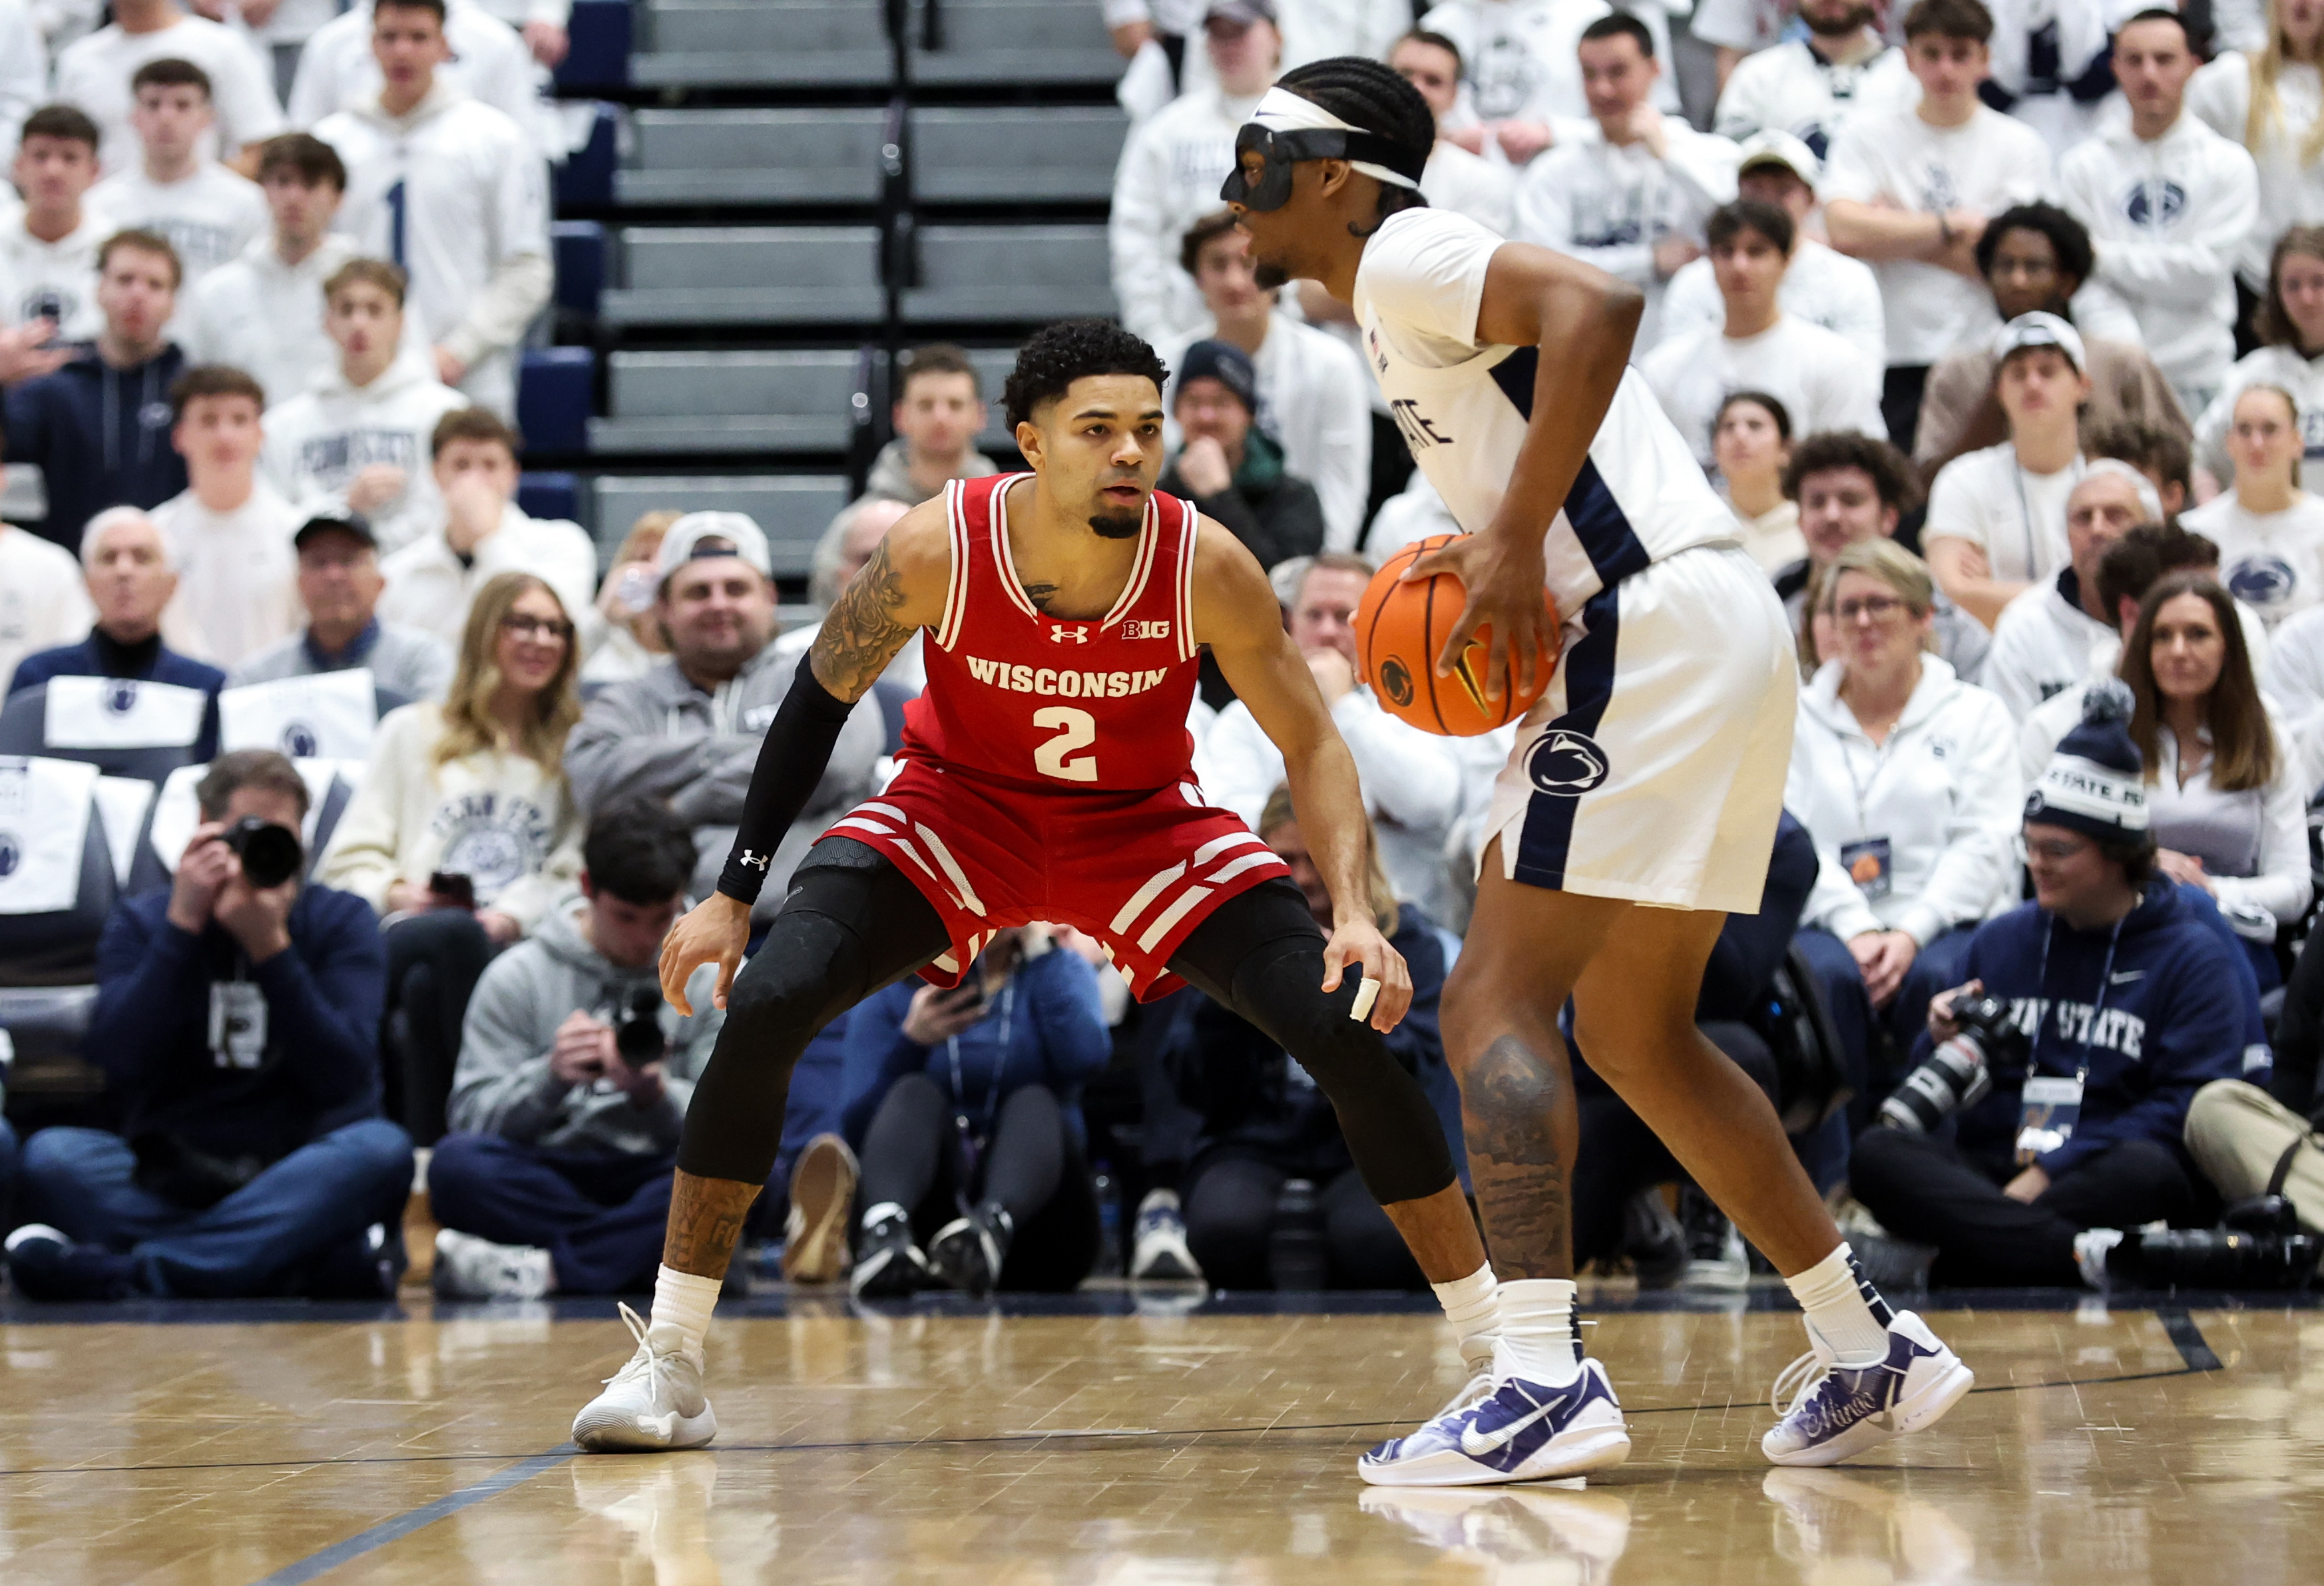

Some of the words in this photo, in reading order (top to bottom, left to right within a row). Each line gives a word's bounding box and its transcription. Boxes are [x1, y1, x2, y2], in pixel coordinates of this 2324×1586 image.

[966, 655, 1168, 697] WISCONSIN
[1033, 706, 1098, 782] 2
[2057, 1000, 2146, 1061] STATE
